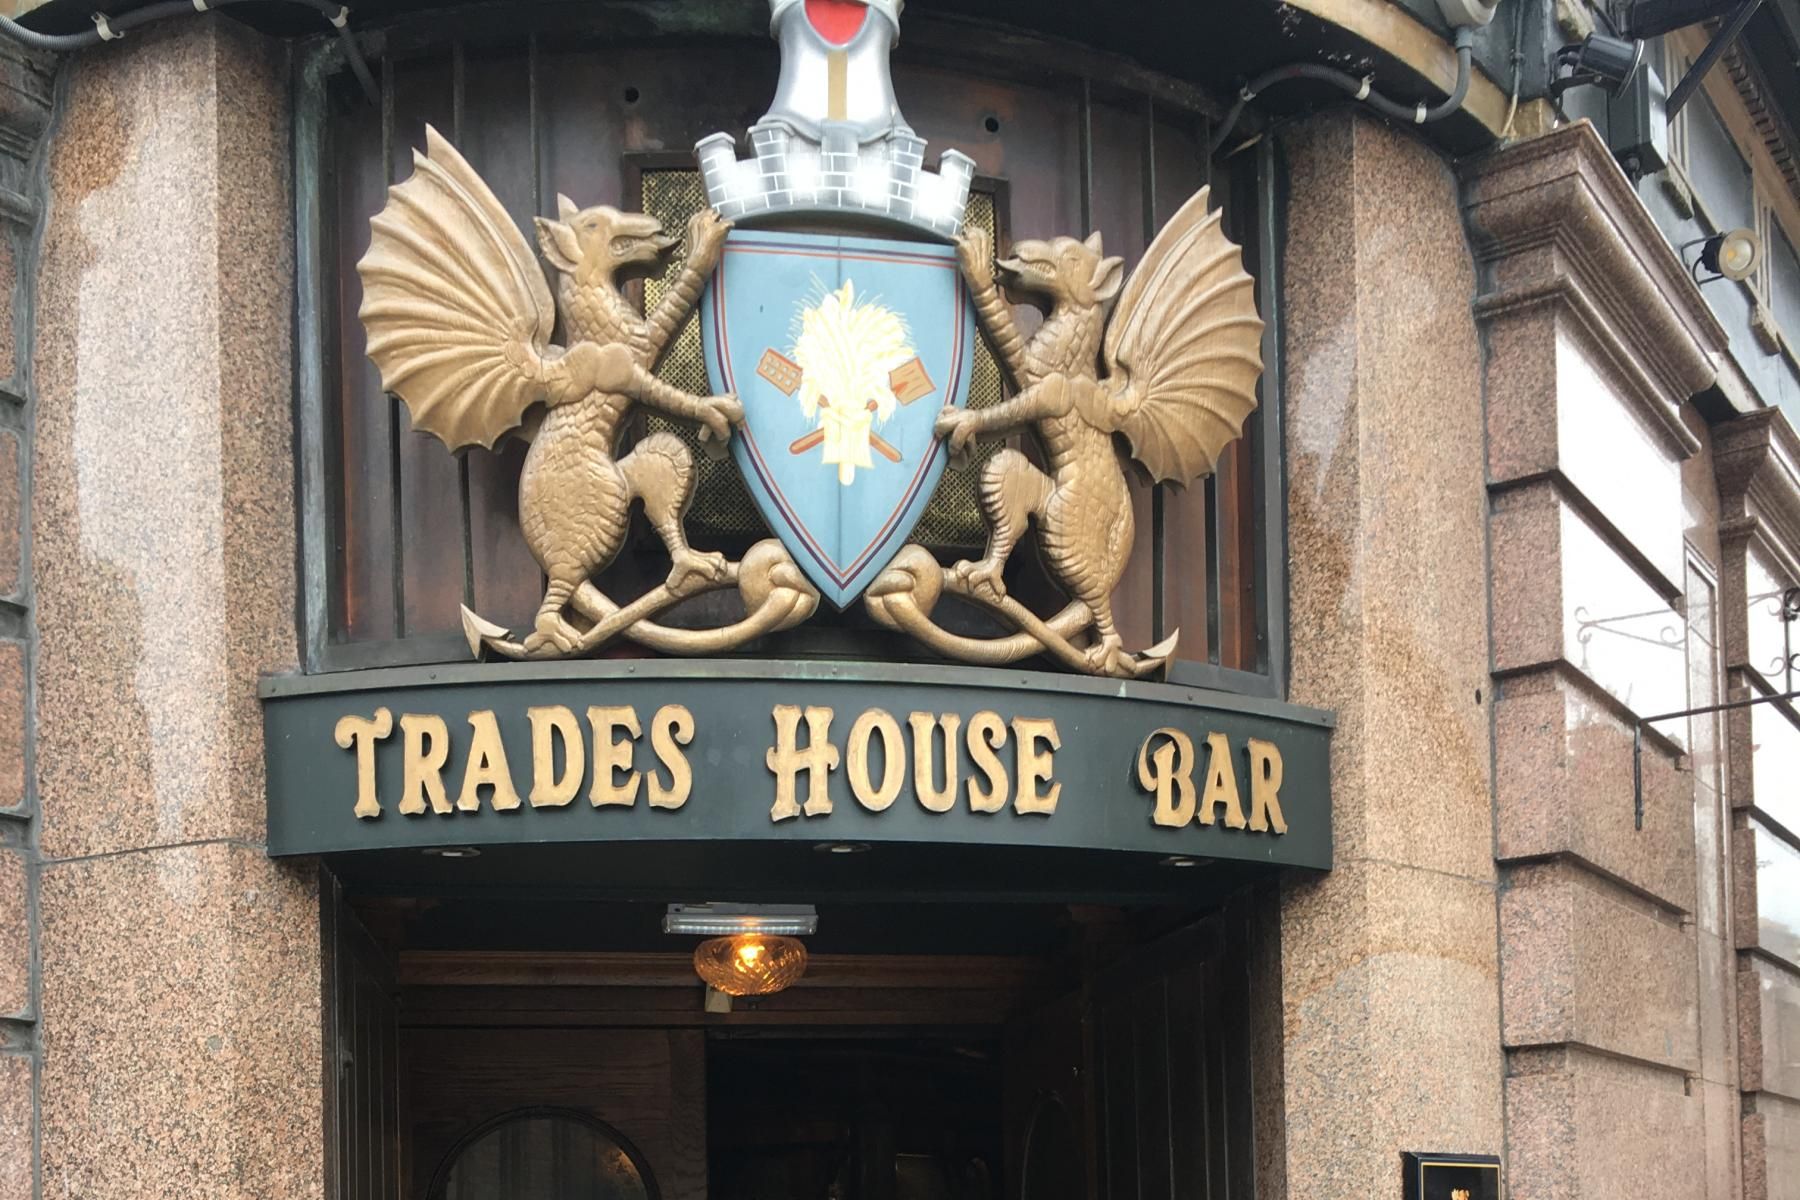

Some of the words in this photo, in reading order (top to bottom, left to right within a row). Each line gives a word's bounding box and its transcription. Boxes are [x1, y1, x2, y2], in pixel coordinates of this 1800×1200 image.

[333, 703, 696, 819] TRADES
[765, 704, 1063, 822] HOUSE
[1138, 727, 1289, 836] BAR
